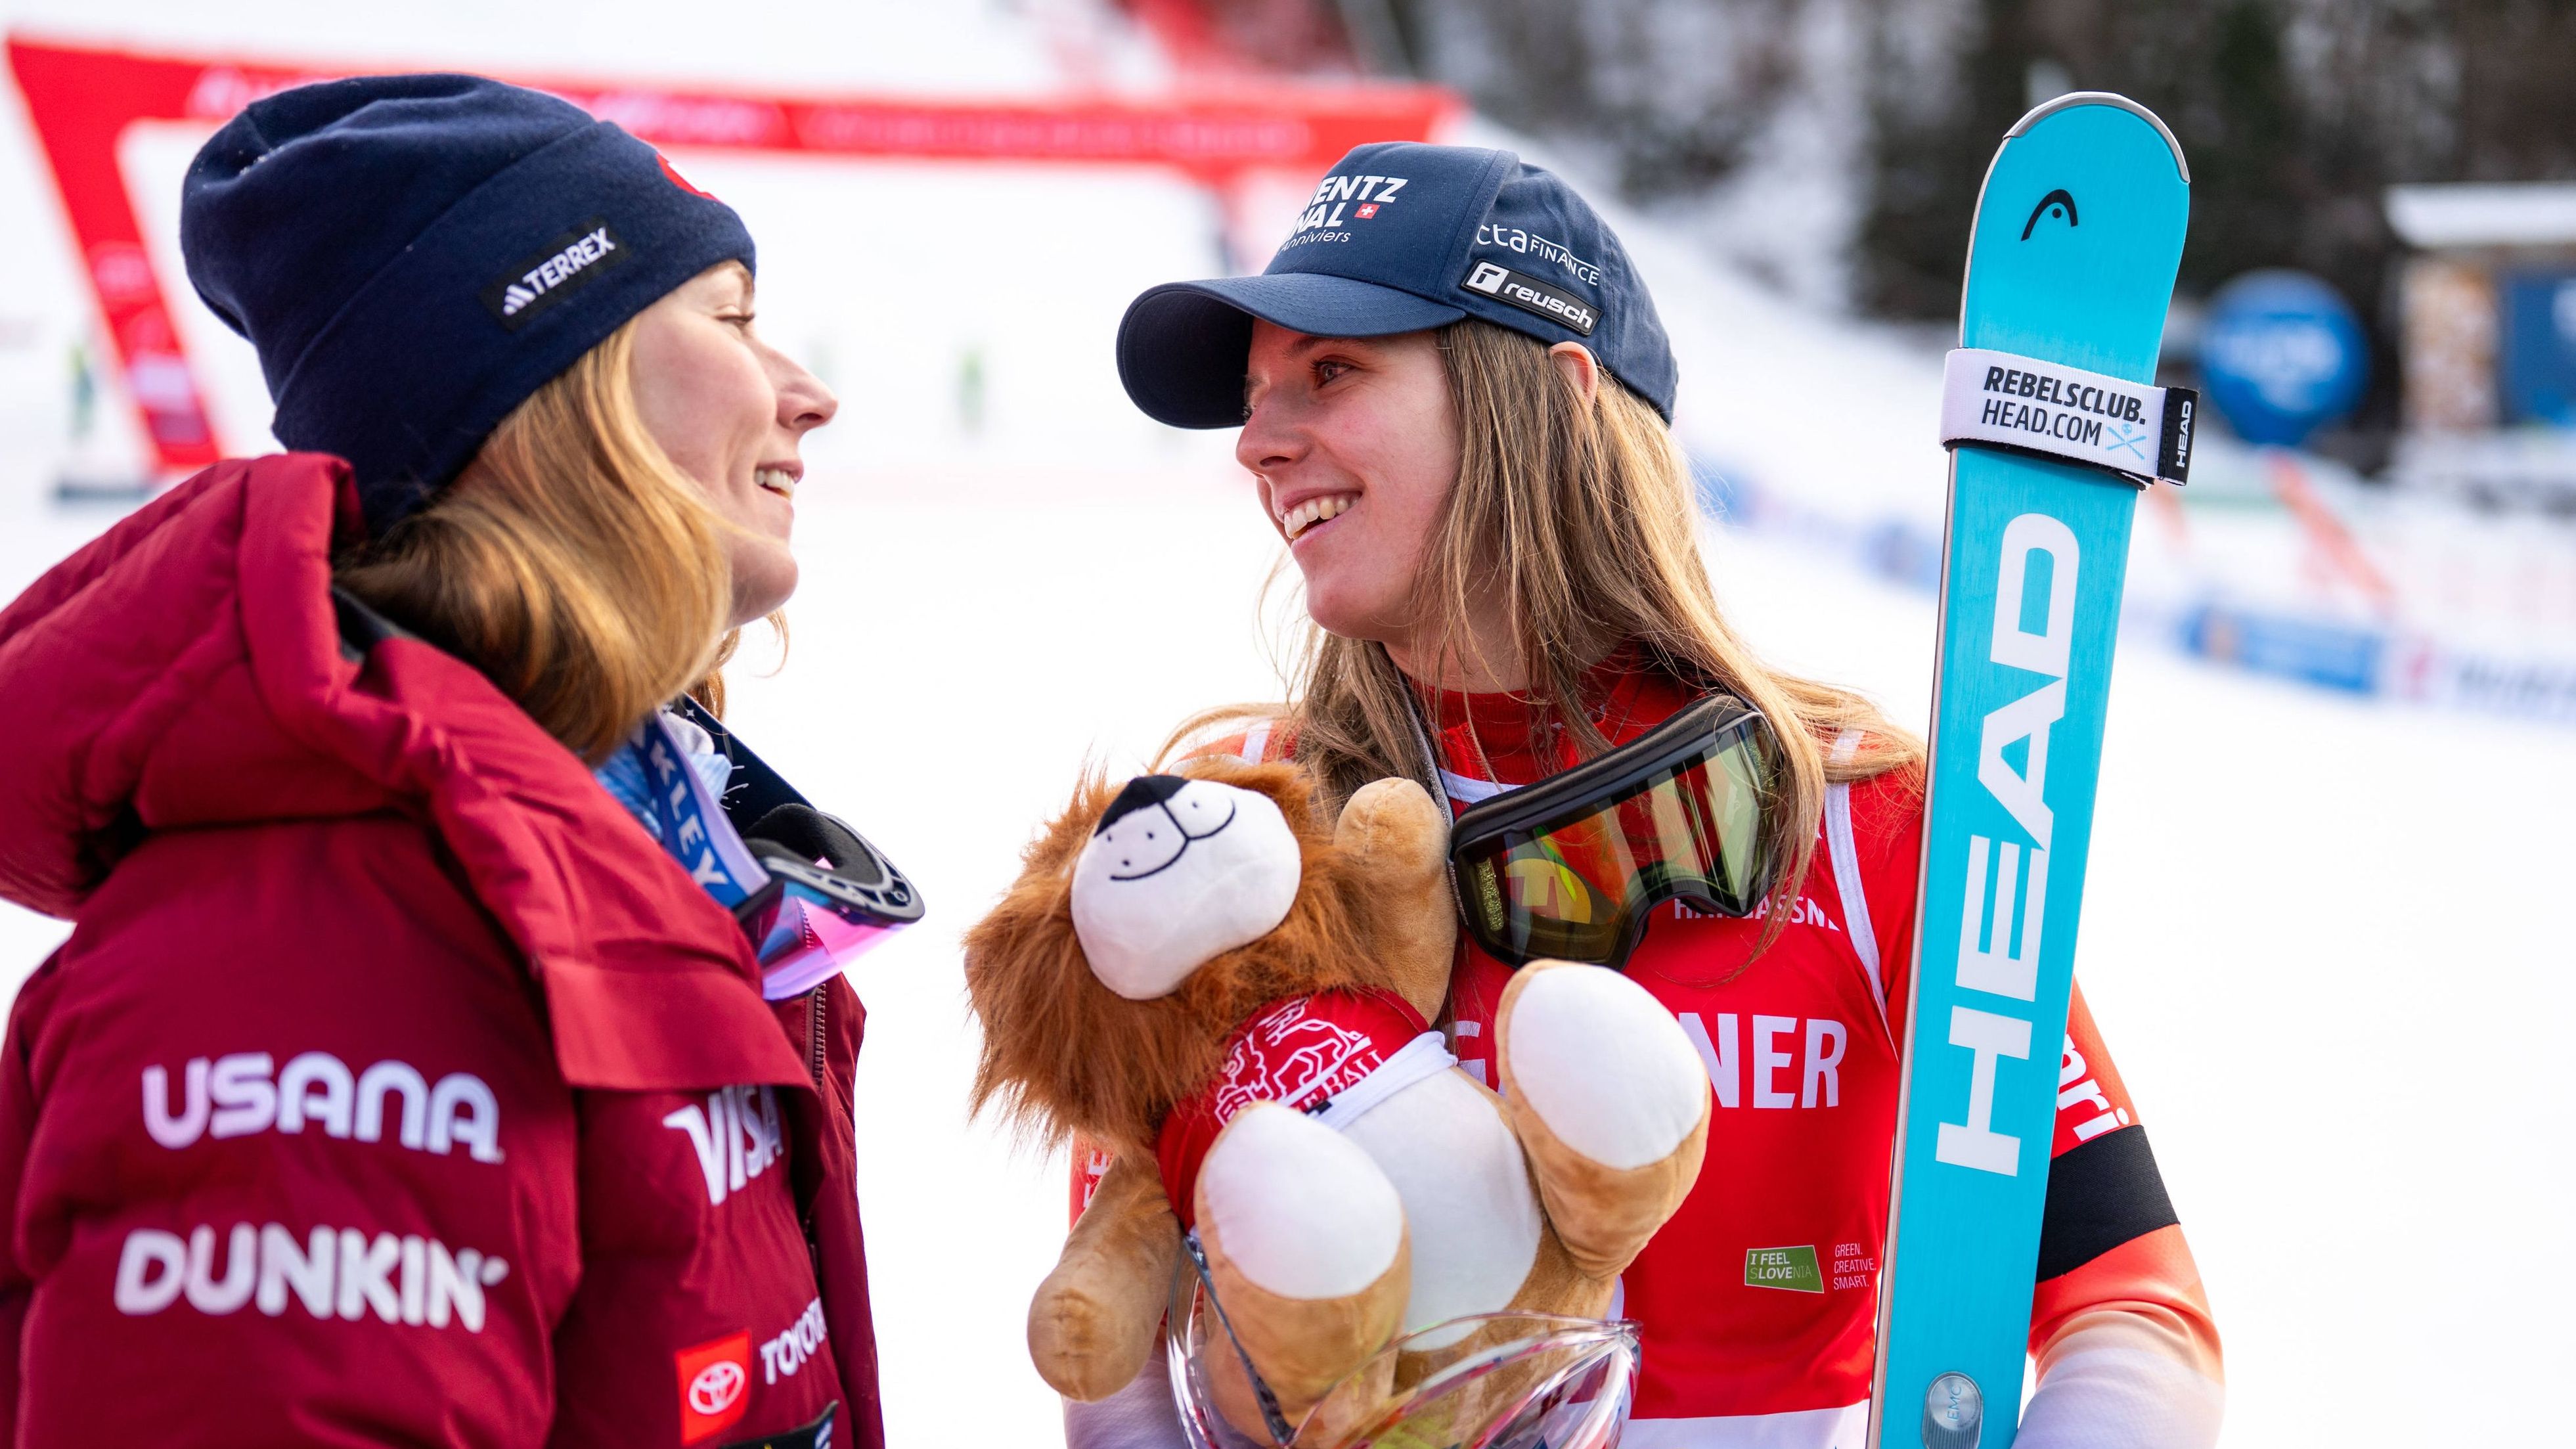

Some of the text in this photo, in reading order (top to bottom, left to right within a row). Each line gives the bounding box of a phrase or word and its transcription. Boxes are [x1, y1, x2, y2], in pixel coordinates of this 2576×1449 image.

[1306, 175, 1408, 210] ENTZ
[1287, 202, 1346, 241] NAL
[522, 227, 616, 296] TERREX
[1530, 238, 1601, 286] FINANCE
[1504, 282, 1593, 328] reusch
[1984, 366, 2146, 424] REBELSCLUB.
[1982, 399, 2102, 446] HEAD.COM
[2176, 401, 2192, 468] HEAD
[1935, 512, 2081, 1176] HEAD
[141, 1051, 504, 1165] USANA
[662, 1084, 784, 1207] VISA
[1749, 1265, 1813, 1280] SLOVENIA
[1750, 1252, 1790, 1265] I FEEL
[1834, 1258, 1876, 1274] CREATIVE.
[1835, 1243, 1863, 1257] GREEN.
[1833, 1274, 1870, 1290] SMART.
